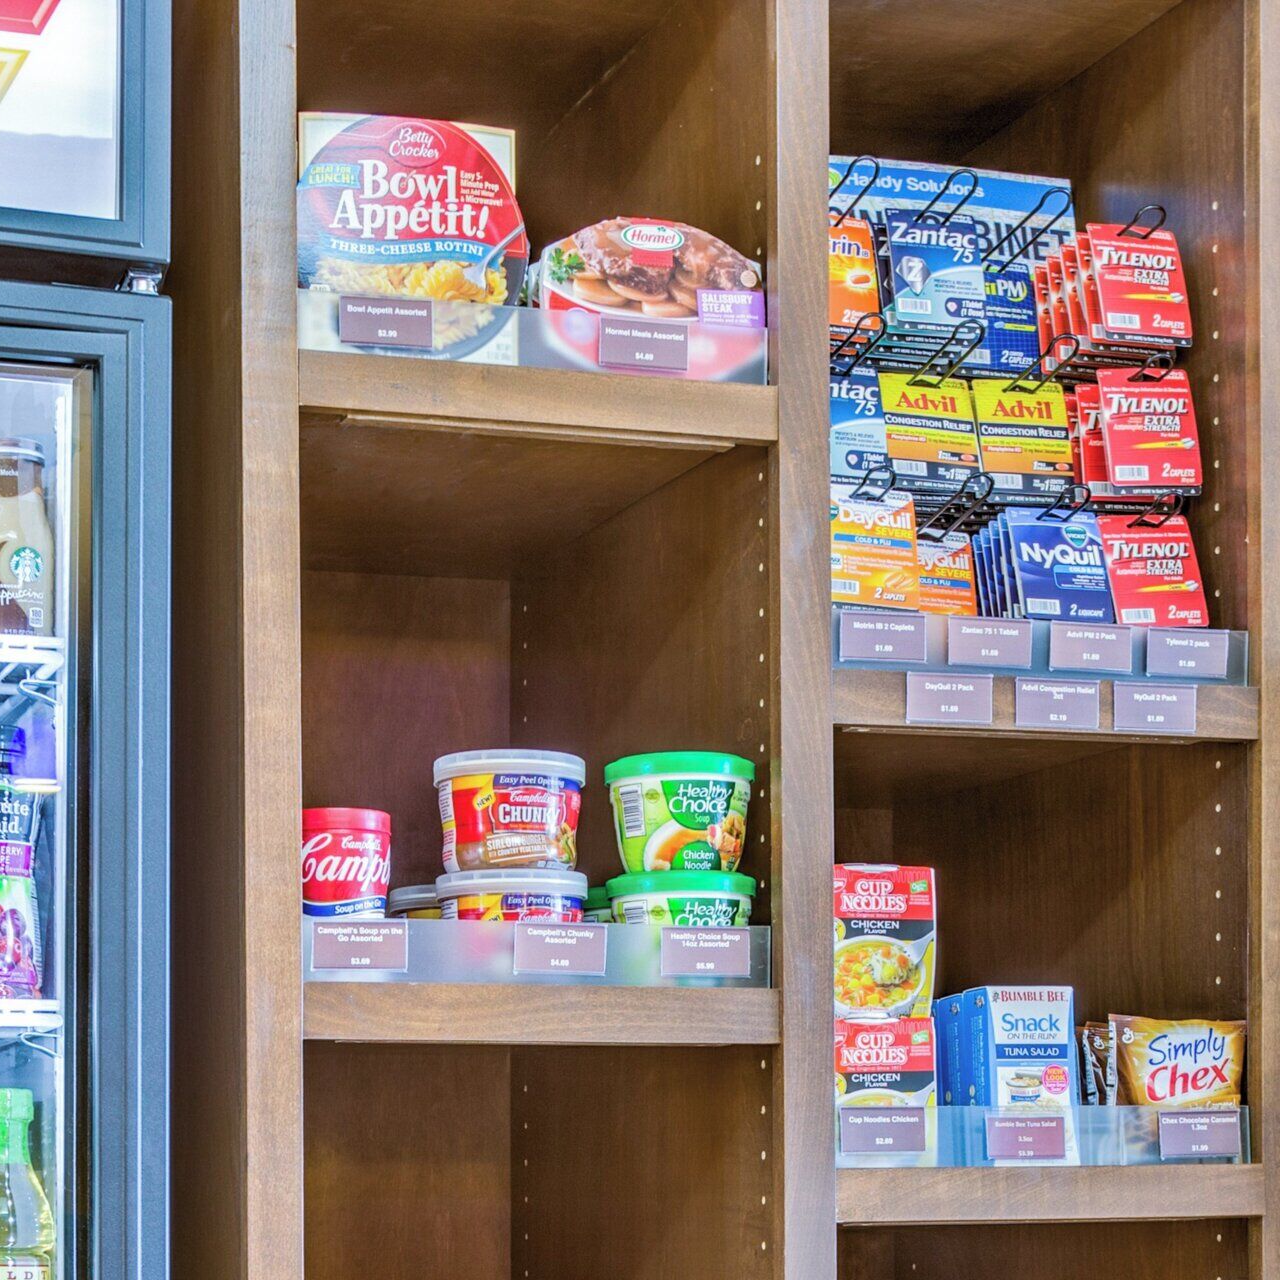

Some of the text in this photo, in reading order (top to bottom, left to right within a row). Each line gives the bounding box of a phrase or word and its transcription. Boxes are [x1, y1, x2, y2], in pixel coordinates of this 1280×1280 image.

[398, 127, 433, 147] Betty
[388, 140, 439, 160] Crocker
[308, 173, 357, 186] LUNCH!
[358, 159, 461, 203] Bowl
[629, 227, 677, 245] Hormel
[890, 222, 977, 249] Zantac
[329, 239, 484, 257] THREE-CHEESE ROTINI
[953, 247, 973, 263] 75
[1096, 245, 1176, 270] TYLENOL
[1134, 268, 1169, 279] EXTRA
[702, 293, 754, 305] SALISBURY
[702, 304, 733, 314] STEAK
[895, 390, 958, 414] Advil
[993, 399, 1053, 419] Advil
[1106, 394, 1188, 416] TYLENOL
[884, 413, 972, 433] CONGESTION RELIEF
[0, 469, 19, 477] Mocha
[839, 507, 912, 531] DayQuil
[875, 527, 913, 539] SEVERE
[1020, 544, 1102, 569] NyQuil
[1107, 541, 1189, 564] TYLENOL
[677, 784, 733, 801] Healthy
[668, 796, 727, 814] Choice
[683, 849, 715, 861] Chicken
[684, 860, 712, 869] Noodle
[857, 879, 894, 897] CUP
[840, 895, 908, 914] NOODLES
[851, 919, 899, 930] CHICKEN
[1001, 1012, 1060, 1033] Snack
[1003, 1046, 1060, 1057] TUNA SALAD
[1148, 1033, 1225, 1067] Simply
[1146, 1059, 1230, 1102] Chex
